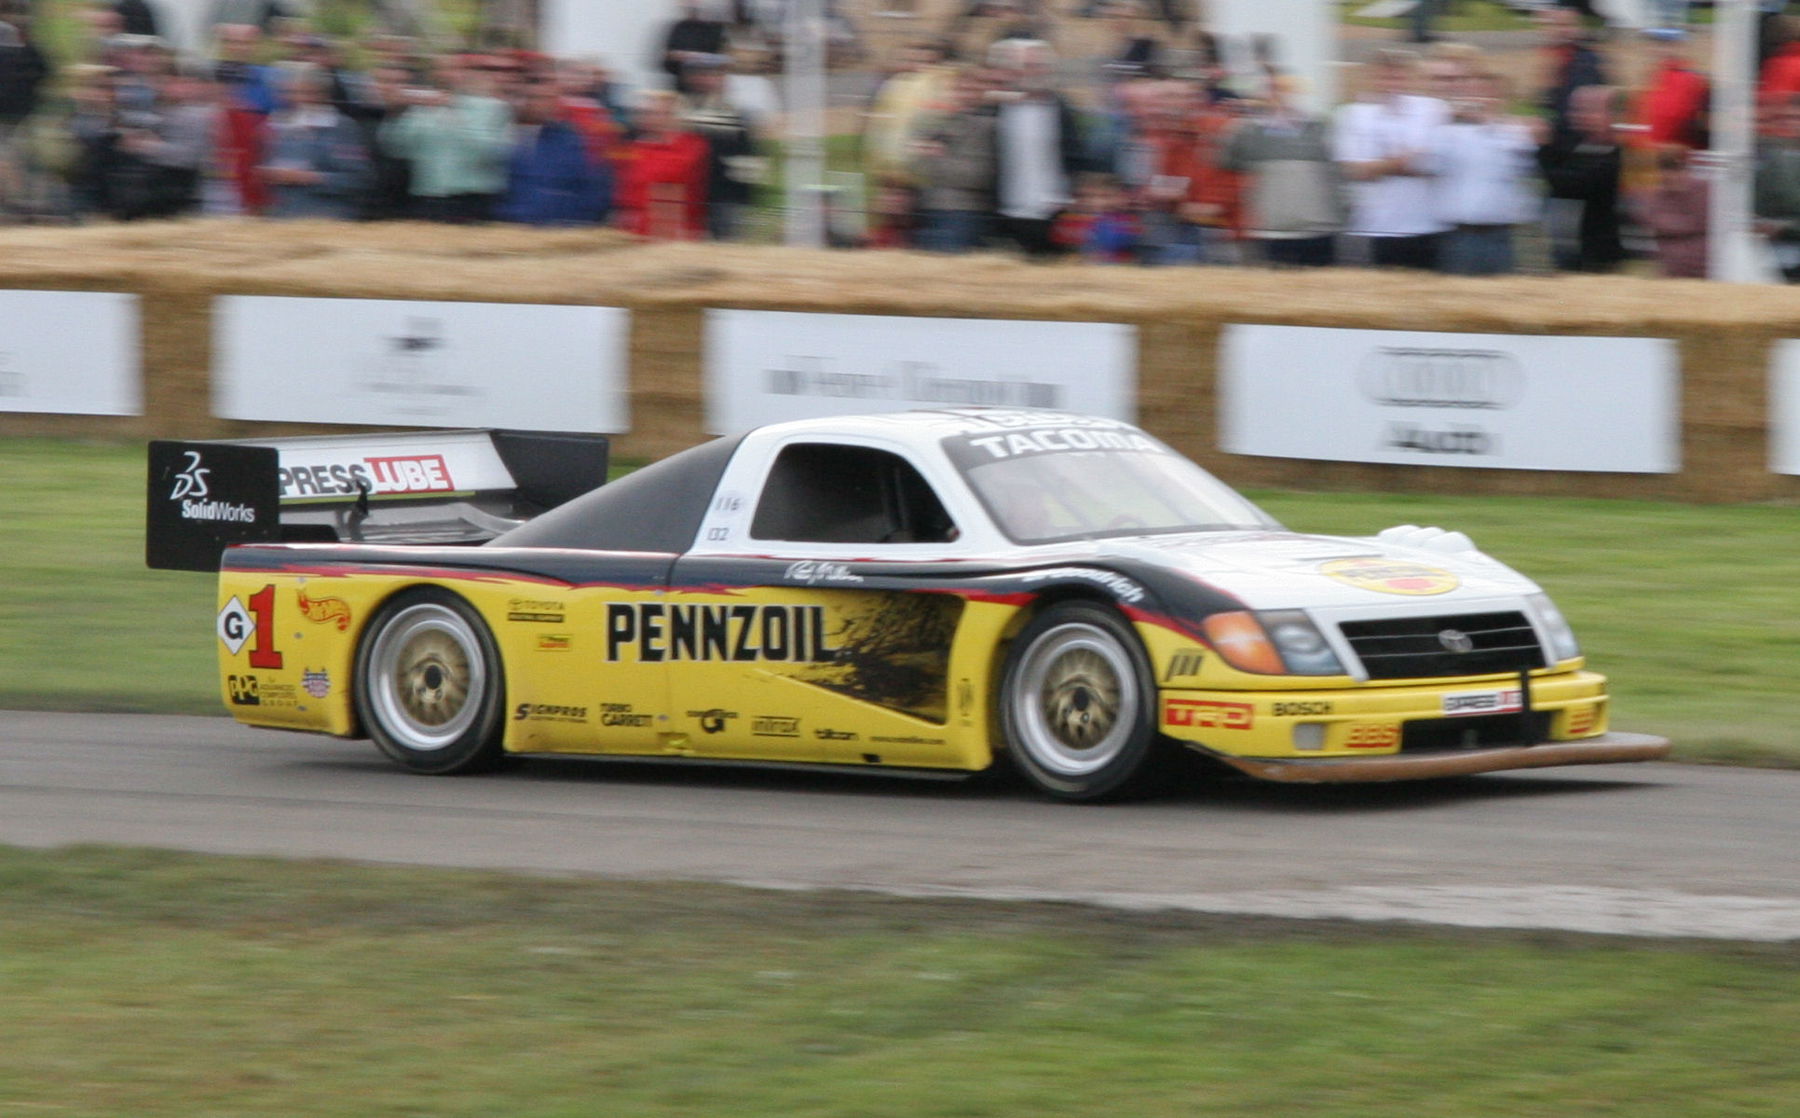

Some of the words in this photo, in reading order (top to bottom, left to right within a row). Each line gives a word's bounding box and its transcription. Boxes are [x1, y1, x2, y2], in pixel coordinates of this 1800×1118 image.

[970, 429, 1157, 458] TACOMA
[182, 498, 255, 523] SolidWorks
[224, 611, 244, 640] G
[248, 584, 283, 670] 1
[604, 602, 842, 663] PENNZOIL
[1273, 702, 1332, 717] BOSCH
